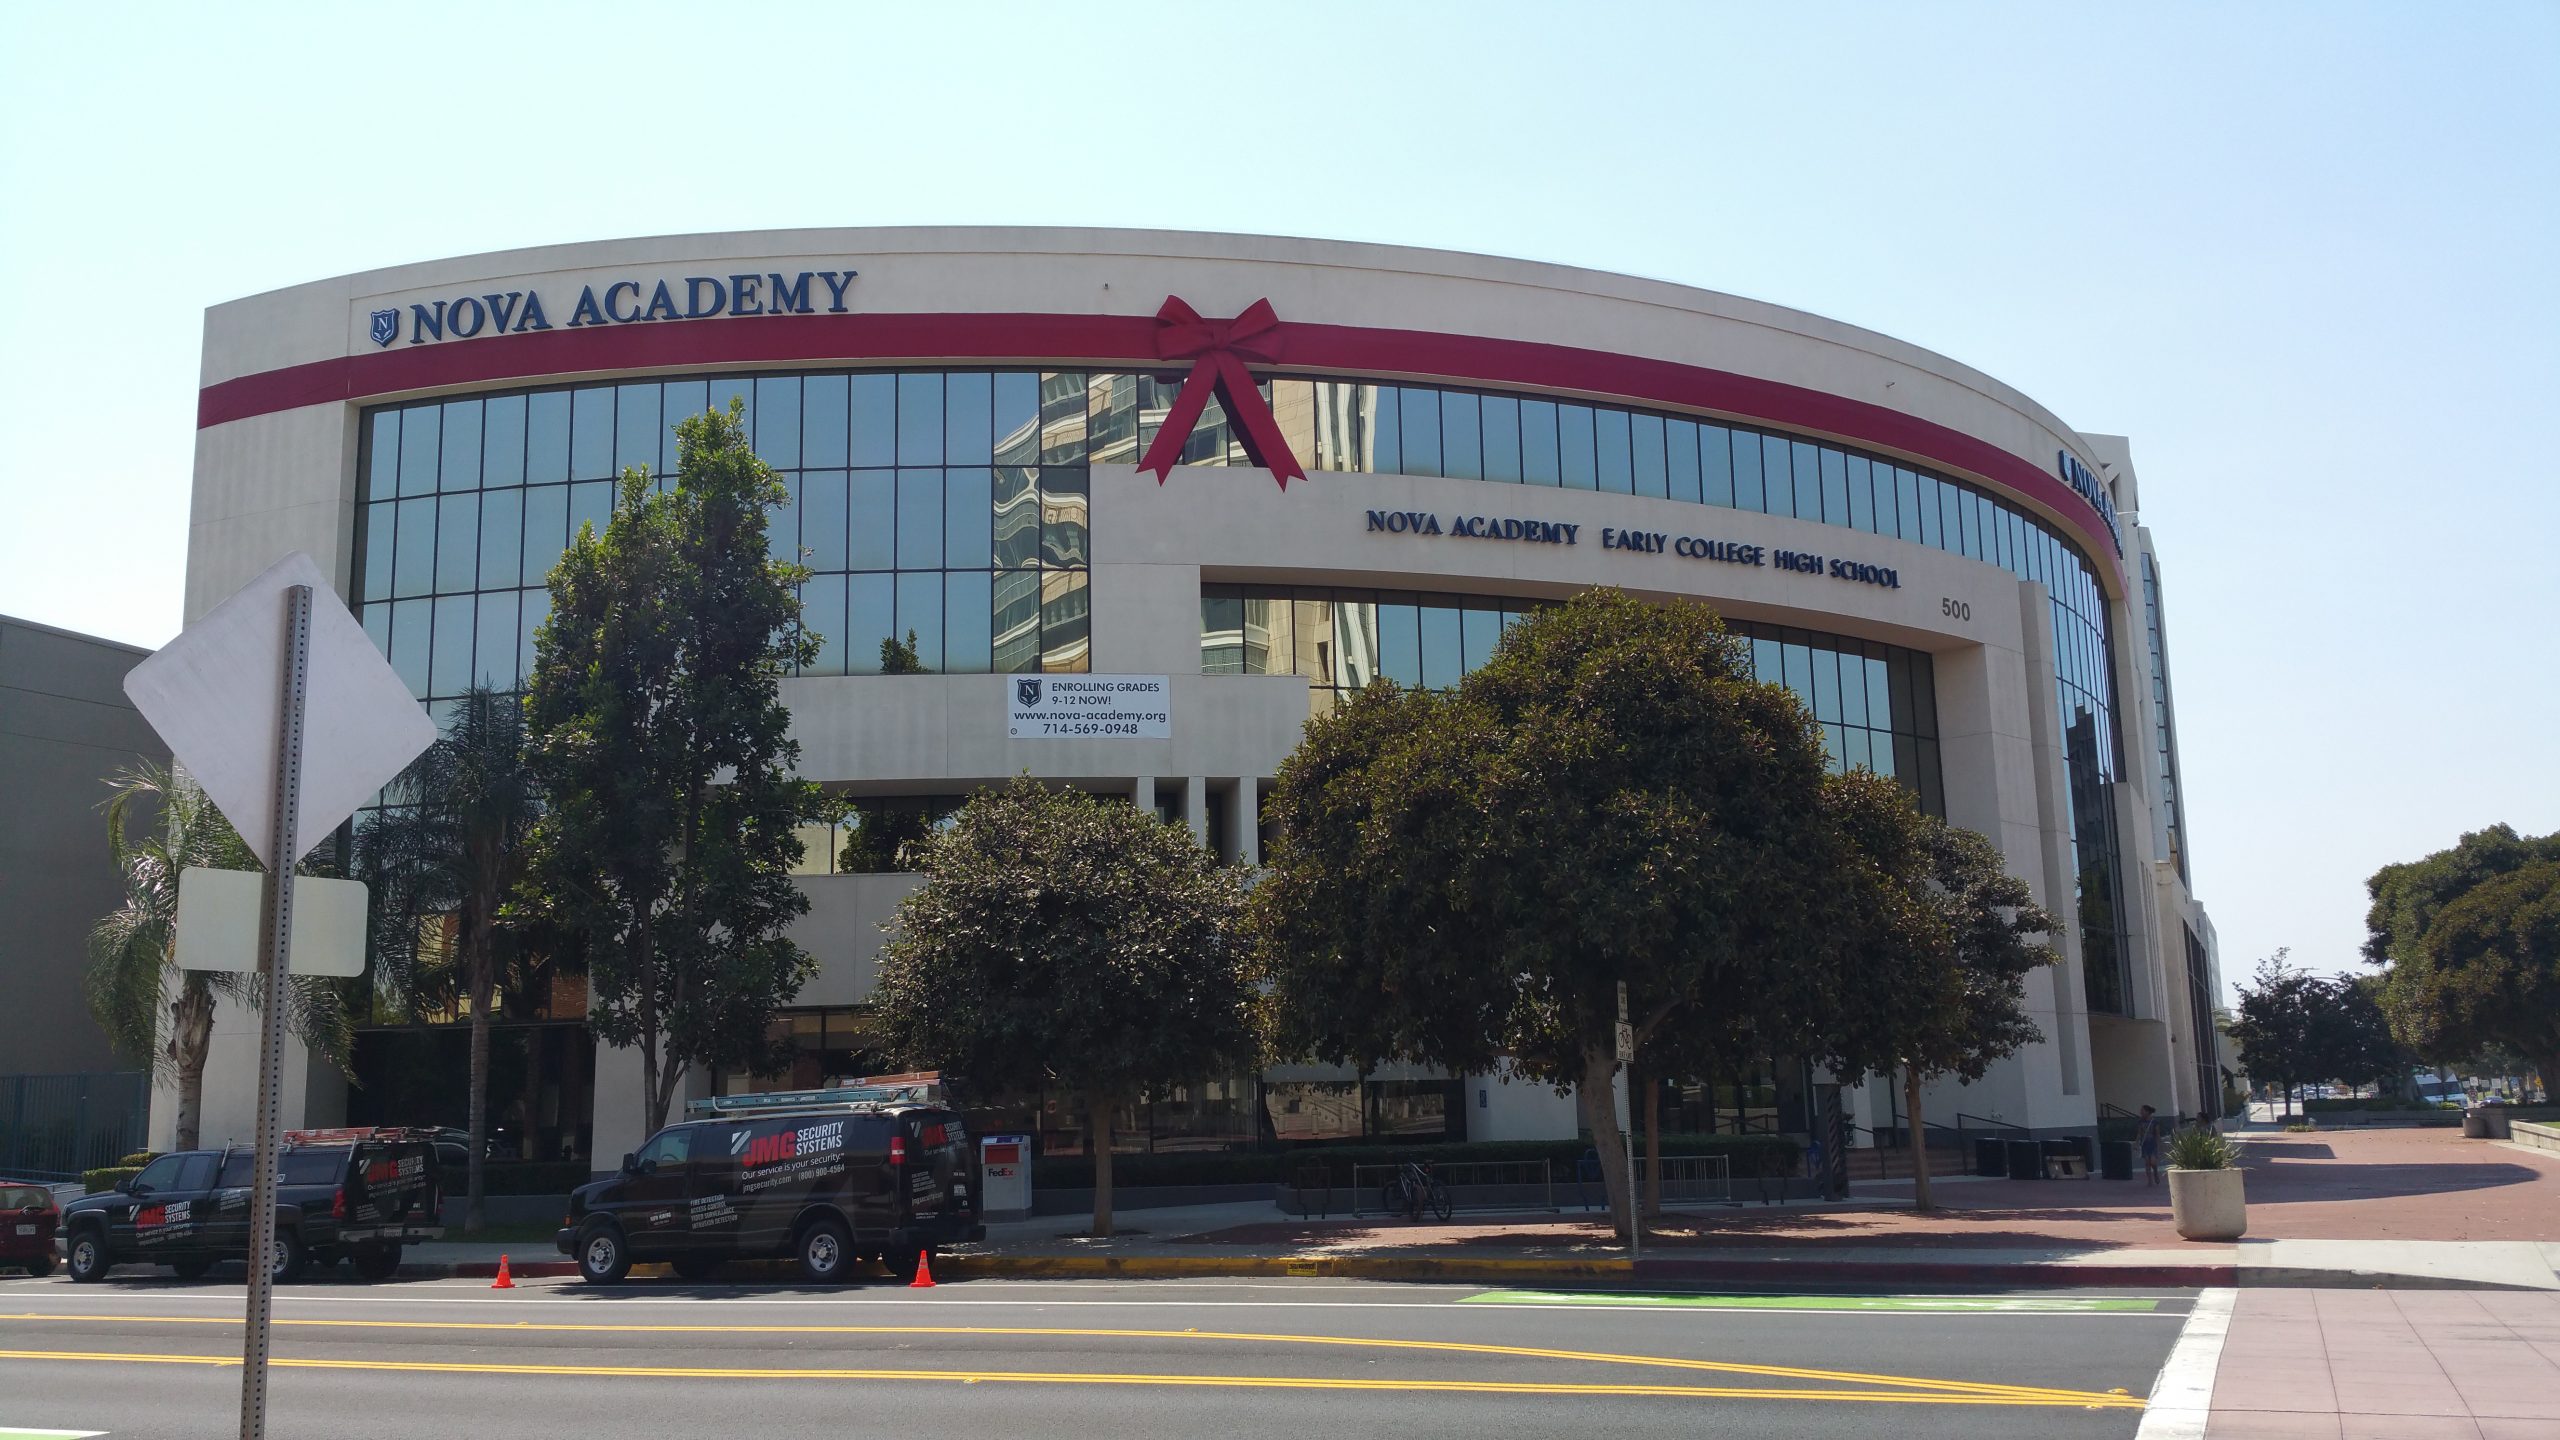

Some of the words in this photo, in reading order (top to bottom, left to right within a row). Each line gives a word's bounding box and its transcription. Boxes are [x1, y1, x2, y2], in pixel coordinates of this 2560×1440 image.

[409, 290, 553, 345] NOVA
[566, 270, 859, 327] ACADEMY
[1366, 509, 1443, 536] NOVA
[1451, 516, 1580, 545] ACADEMY
[1602, 527, 1669, 555] EARLY
[1675, 536, 1766, 568] COLLEGE
[1773, 549, 1824, 576] HIGH
[1829, 558, 1902, 590] SCHOOL
[1942, 597, 1971, 622] 500
[1052, 682, 1114, 692] ENROLLING
[1116, 682, 1160, 692] GRADES
[1052, 696, 1076, 705] 9-12
[1078, 696, 1111, 705] NOW!
[1014, 710, 1166, 722] www.nova-academy.org
[1043, 723, 1138, 735] 714-569-0948
[796, 1121, 844, 1142] SECURITY
[742, 1130, 797, 1167] JMG
[796, 1135, 843, 1156] SYSTEMS
[741, 1170, 757, 1180] Our
[757, 1165, 783, 1177] service
[784, 1162, 791, 1171] is
[791, 1160, 809, 1172] your
[988, 1168, 1014, 1177] FedEx
[742, 1175, 792, 1194] jmgsecurity.com
[165, 1200, 191, 1214] SECURITY
[165, 1210, 191, 1224] SYSTEMS
